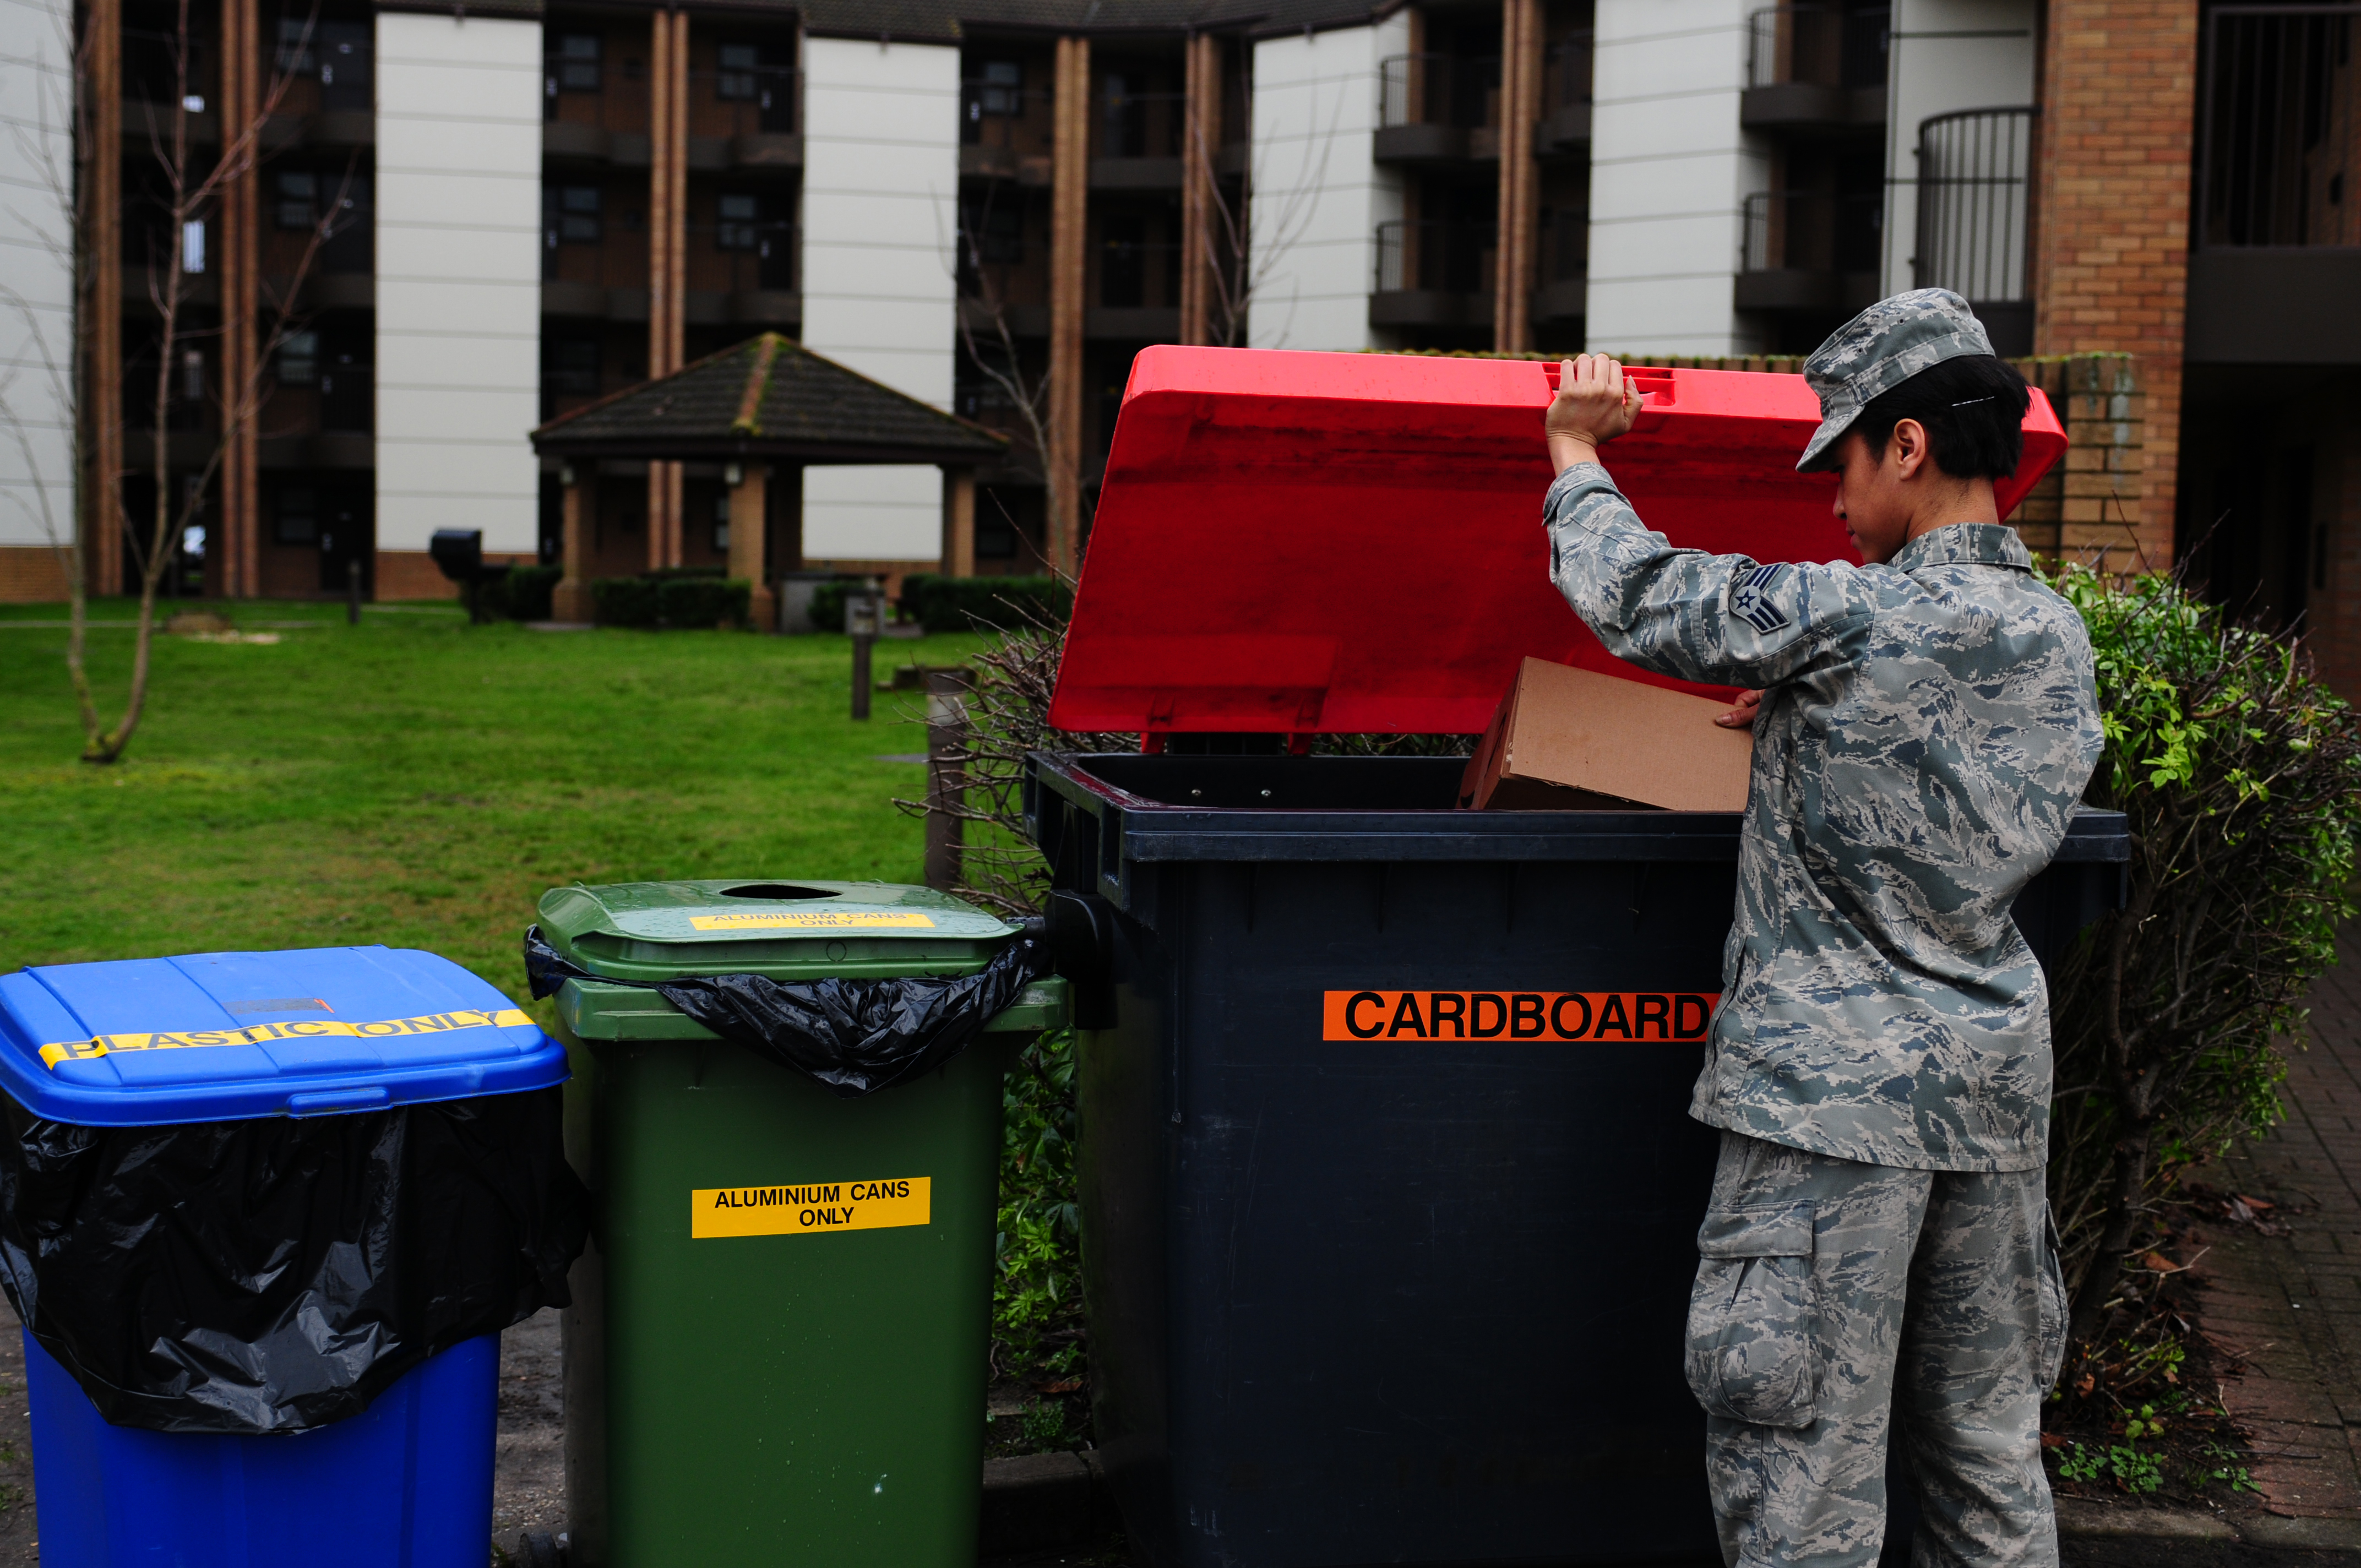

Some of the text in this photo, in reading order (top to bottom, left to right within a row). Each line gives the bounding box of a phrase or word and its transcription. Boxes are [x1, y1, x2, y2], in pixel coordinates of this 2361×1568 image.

[61, 1010, 499, 1058] PLASTIC ONLY
[1345, 991, 1710, 1039] CARDBOARD
[715, 1180, 910, 1208] ALUMINIUM CANS
[799, 1207, 854, 1227] ONLY
